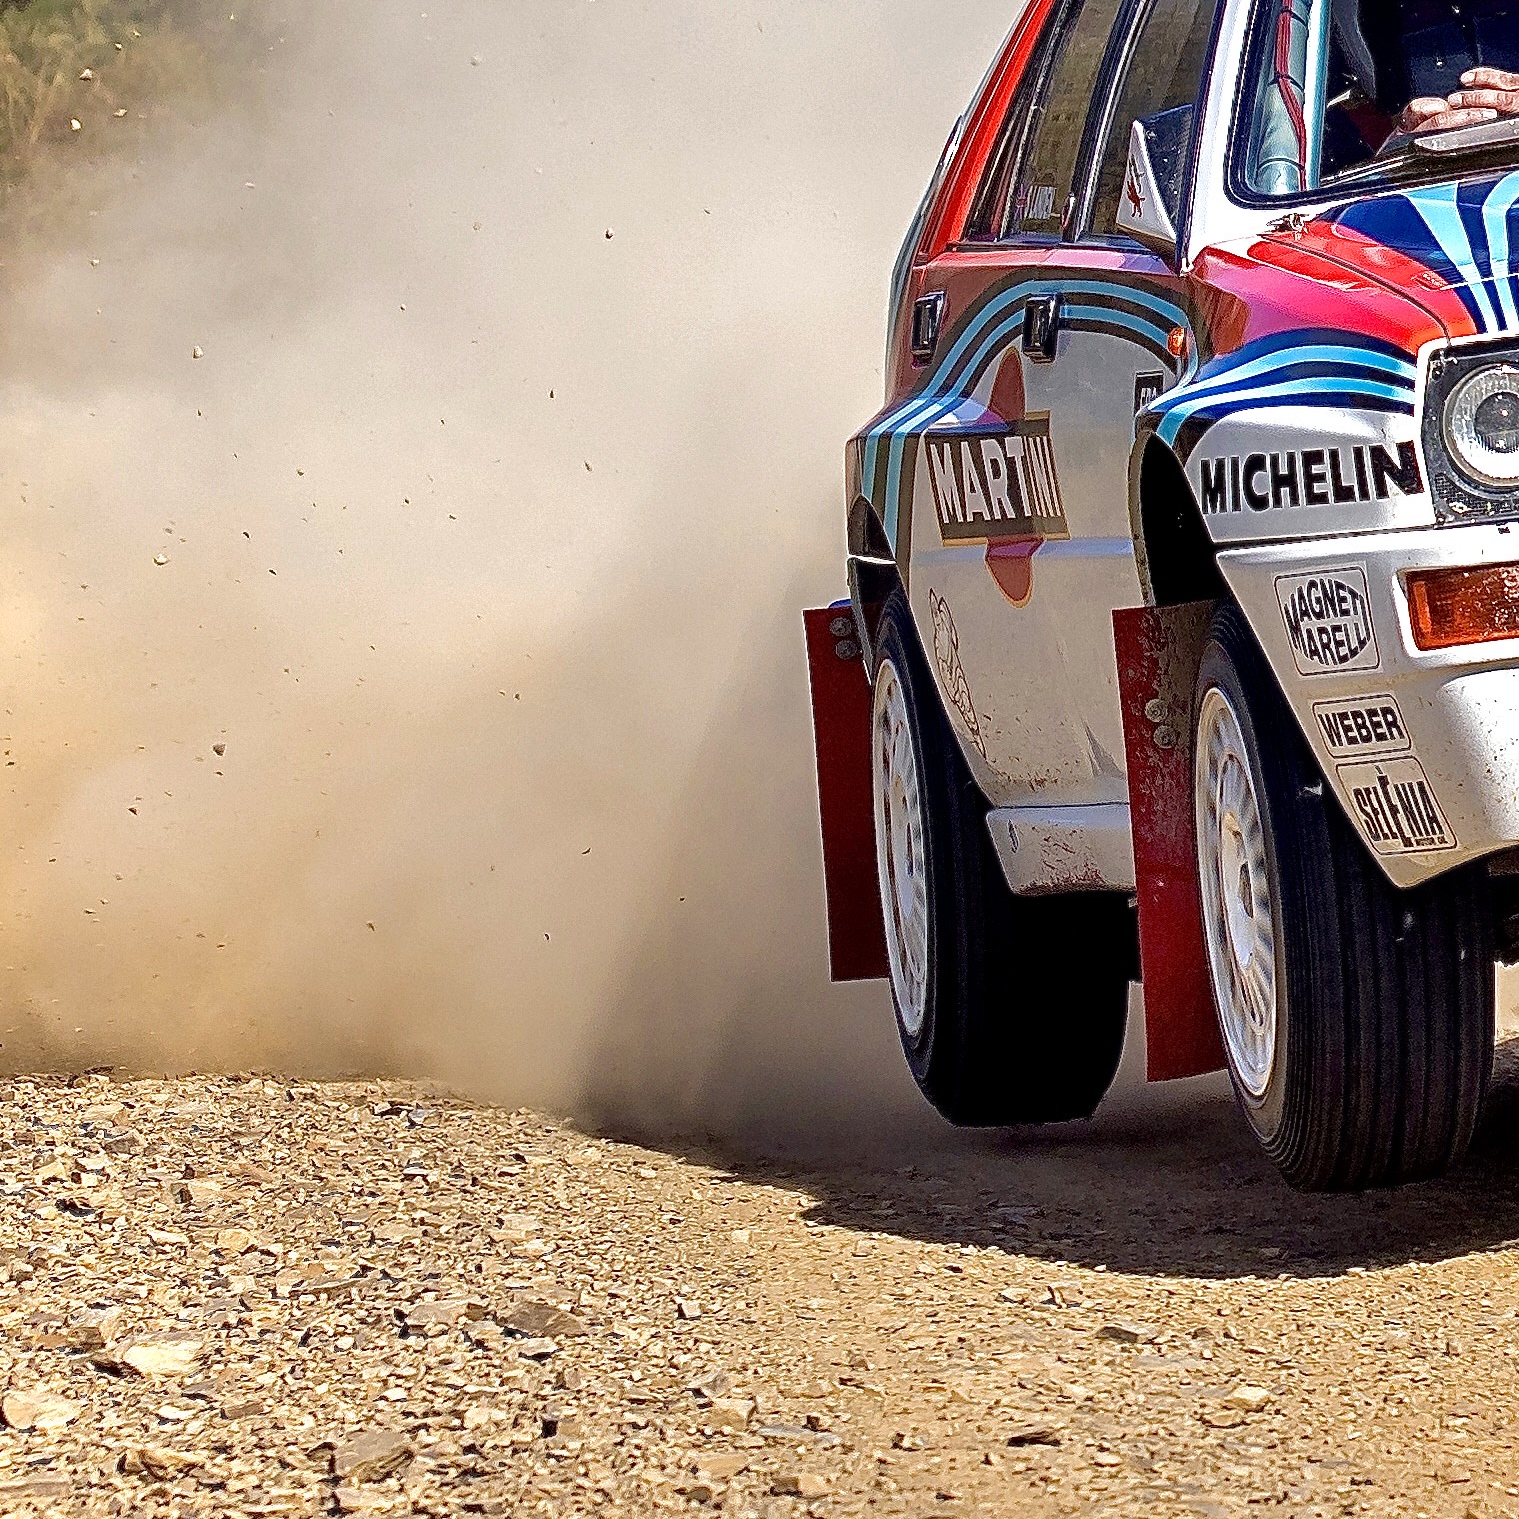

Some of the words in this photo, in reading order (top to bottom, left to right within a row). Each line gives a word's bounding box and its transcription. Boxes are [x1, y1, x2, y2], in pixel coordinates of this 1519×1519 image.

[930, 435, 1062, 524] MARTINI
[1199, 440, 1426, 515] MICHELIN
[1284, 577, 1370, 641] MAGNETI
[1285, 615, 1371, 666] MARELLI
[1318, 706, 1405, 747] WEBER
